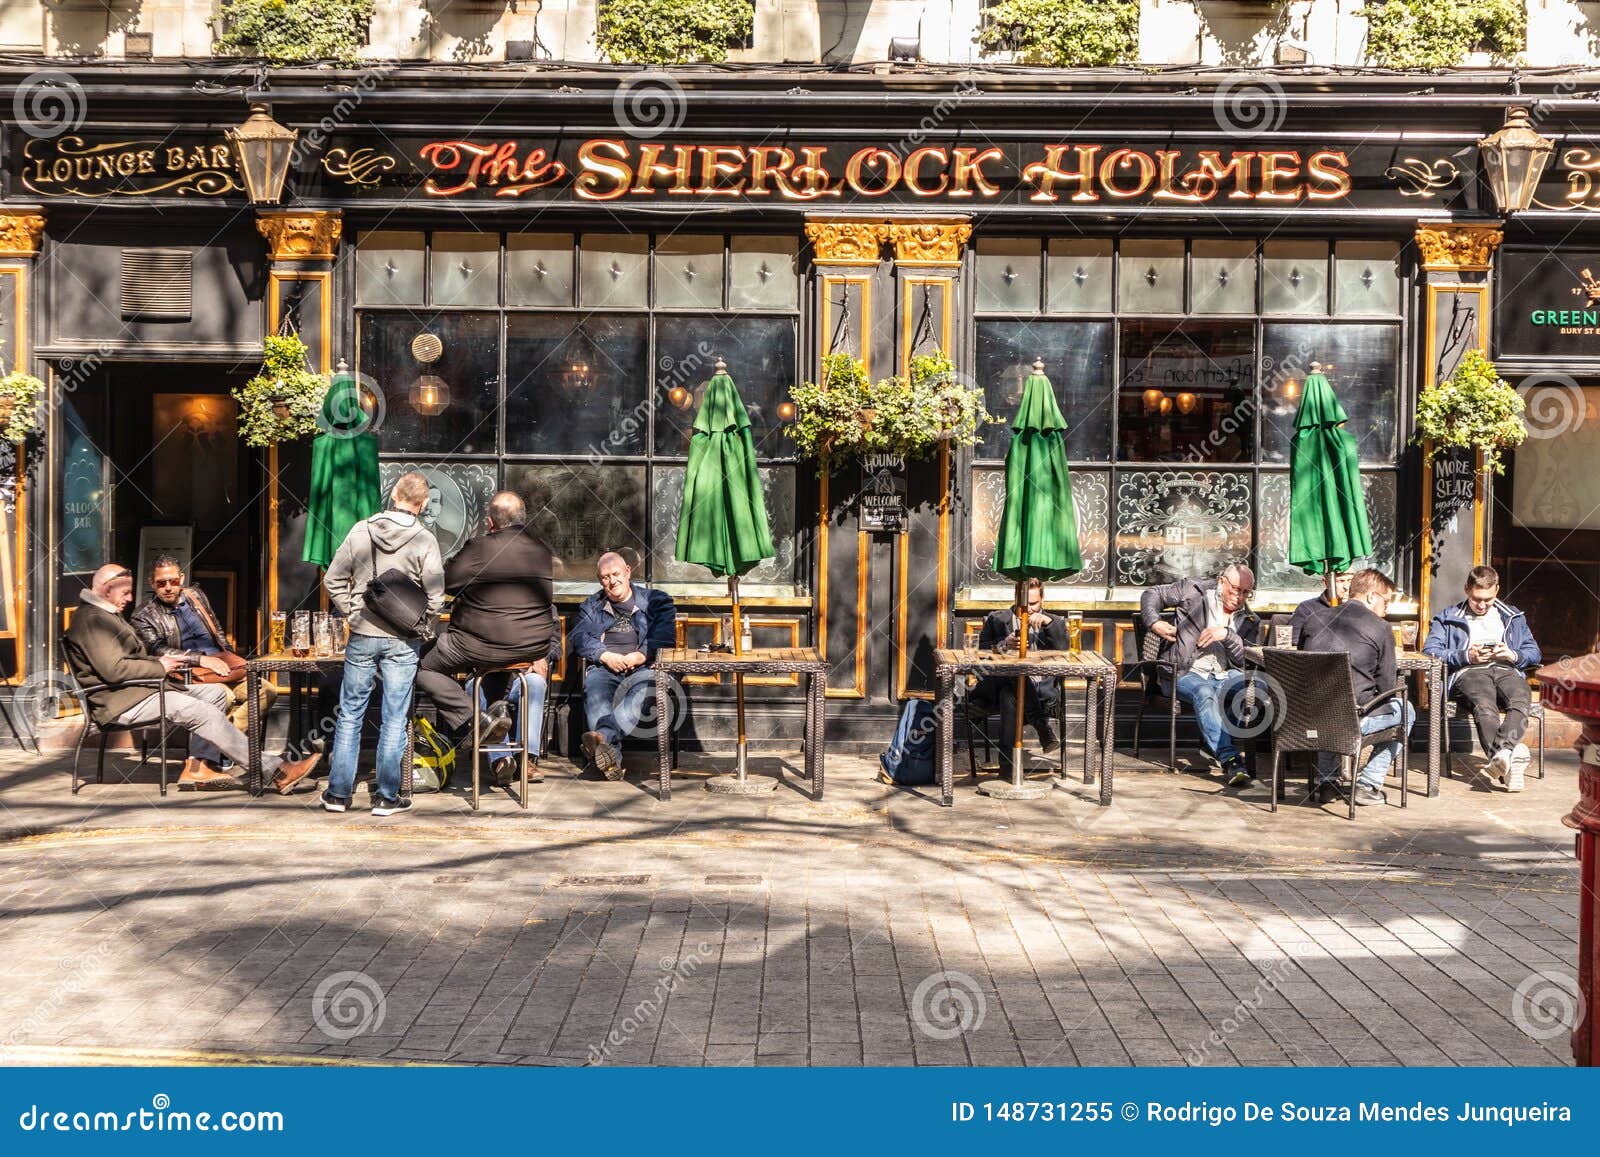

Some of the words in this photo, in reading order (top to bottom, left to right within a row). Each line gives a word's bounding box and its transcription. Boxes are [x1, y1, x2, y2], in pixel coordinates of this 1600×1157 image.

[34, 149, 156, 183] LOUNGE
[166, 144, 231, 171] BAR
[419, 138, 565, 196] The
[574, 139, 1003, 200] SHERLOCK
[1022, 144, 1352, 201] HOLMES
[1531, 310, 1600, 326] GREEN
[1560, 327, 1583, 335] BURY
[1584, 327, 1595, 335] ST
[864, 453, 906, 473] HOUNDS
[1435, 459, 1470, 478] MORE
[1436, 479, 1474, 498] SEATS
[865, 495, 902, 507] WELCOME
[74, 517, 92, 529] BAR
